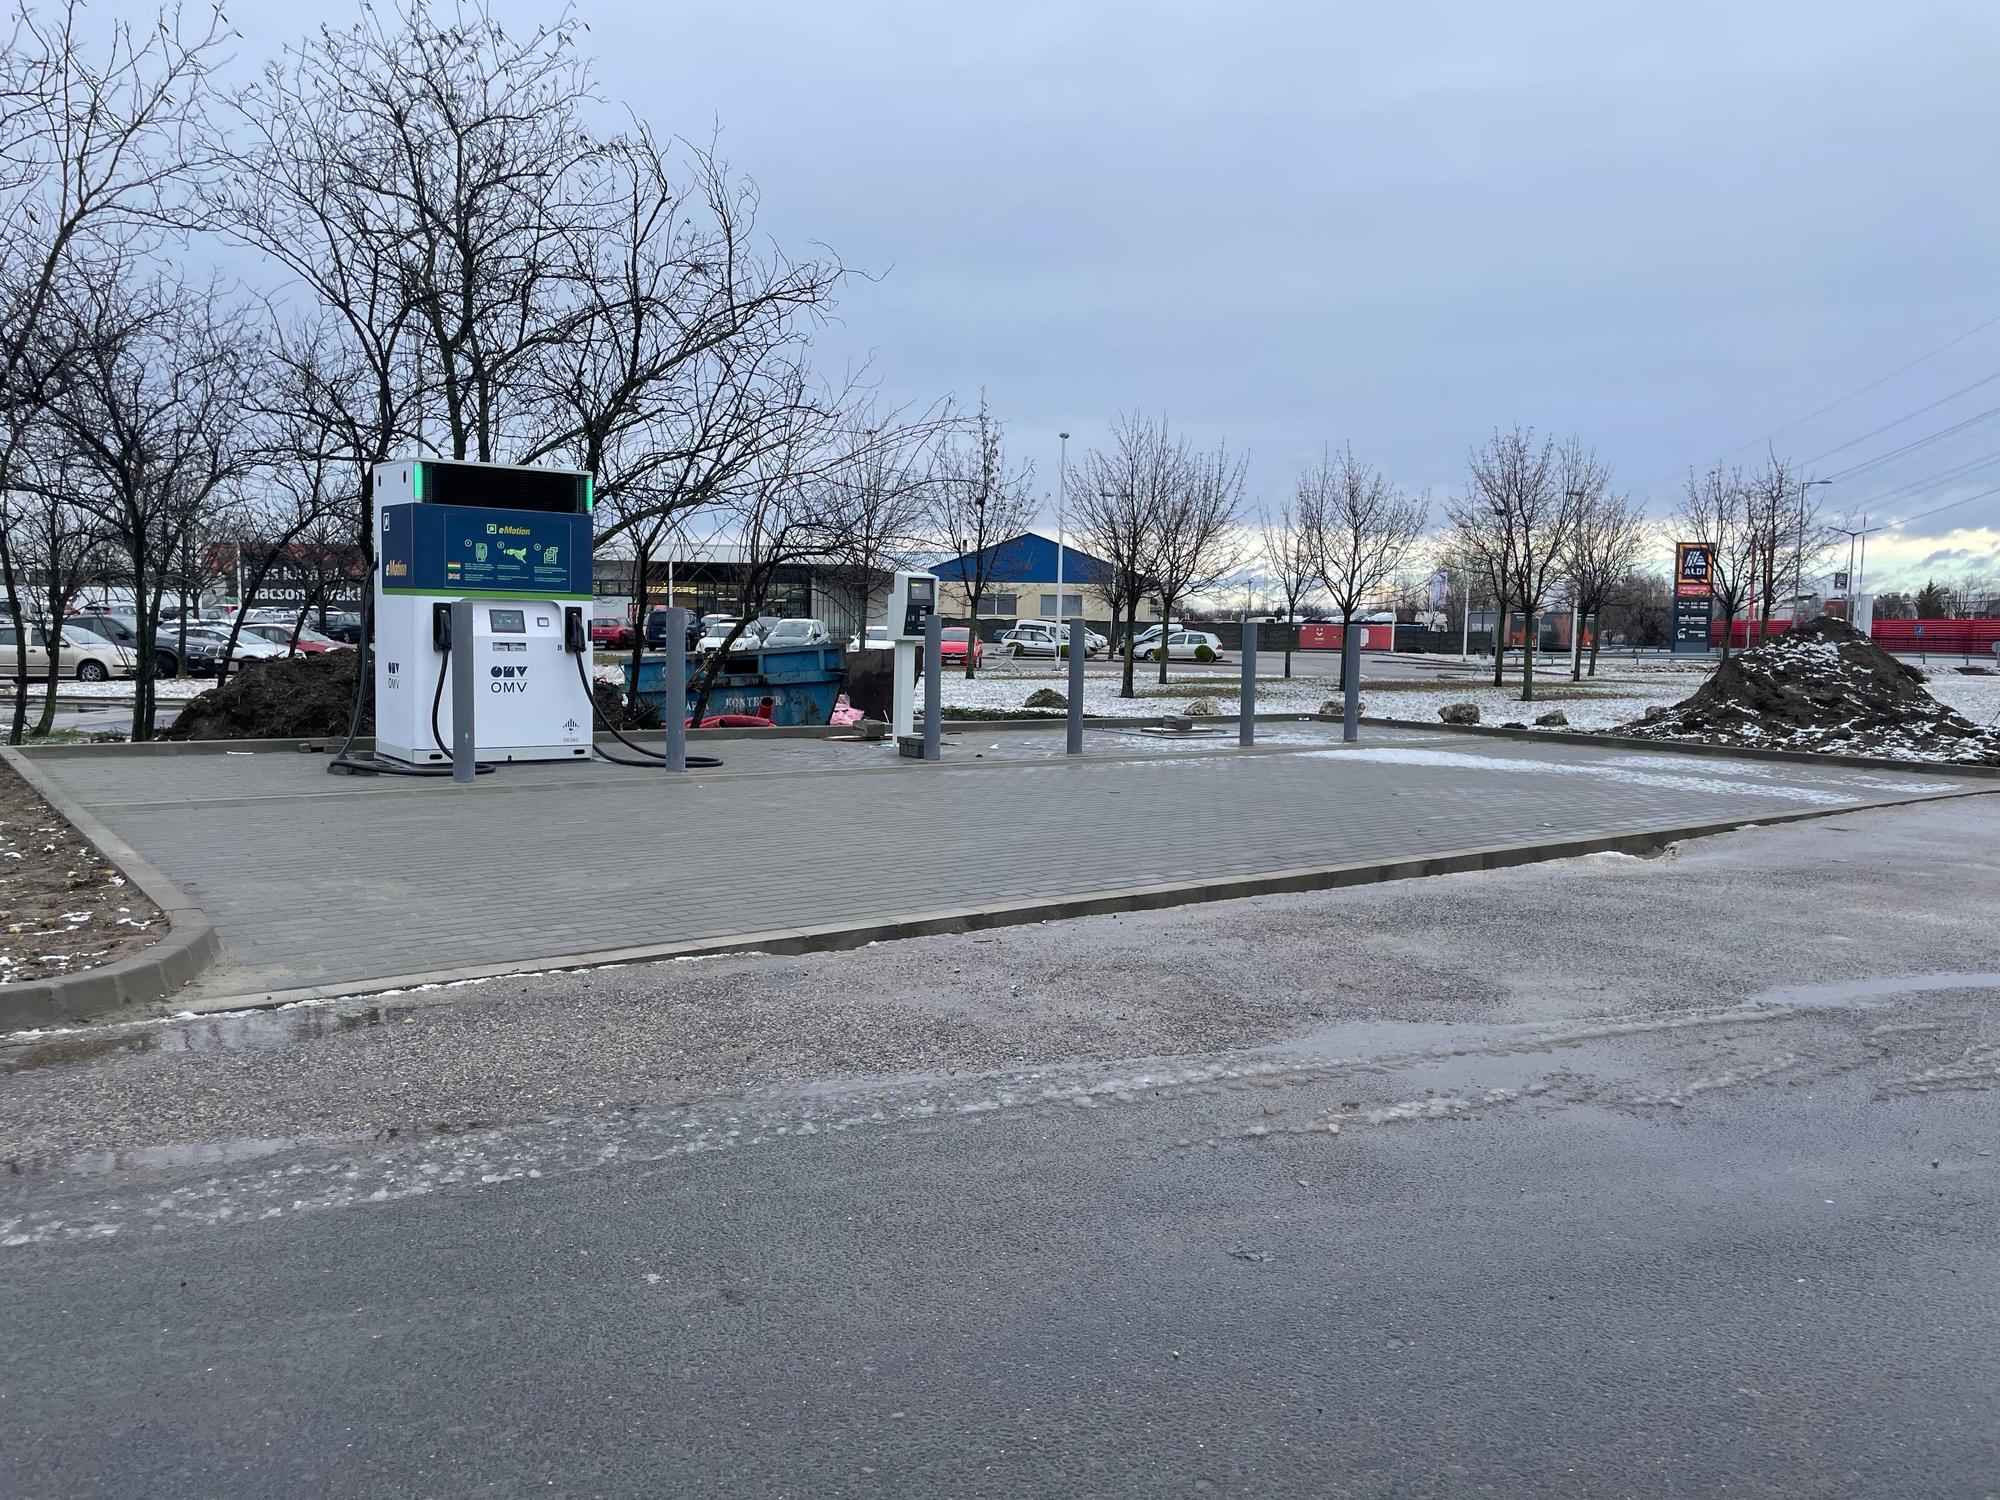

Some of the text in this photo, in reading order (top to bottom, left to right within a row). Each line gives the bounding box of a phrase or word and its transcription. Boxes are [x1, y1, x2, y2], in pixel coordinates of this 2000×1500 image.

[498, 525, 531, 536] eMotion
[1684, 567, 1706, 576] ALDI
[245, 584, 310, 601] lacson
[490, 681, 528, 694] OMV
[725, 695, 783, 709] KONTER
